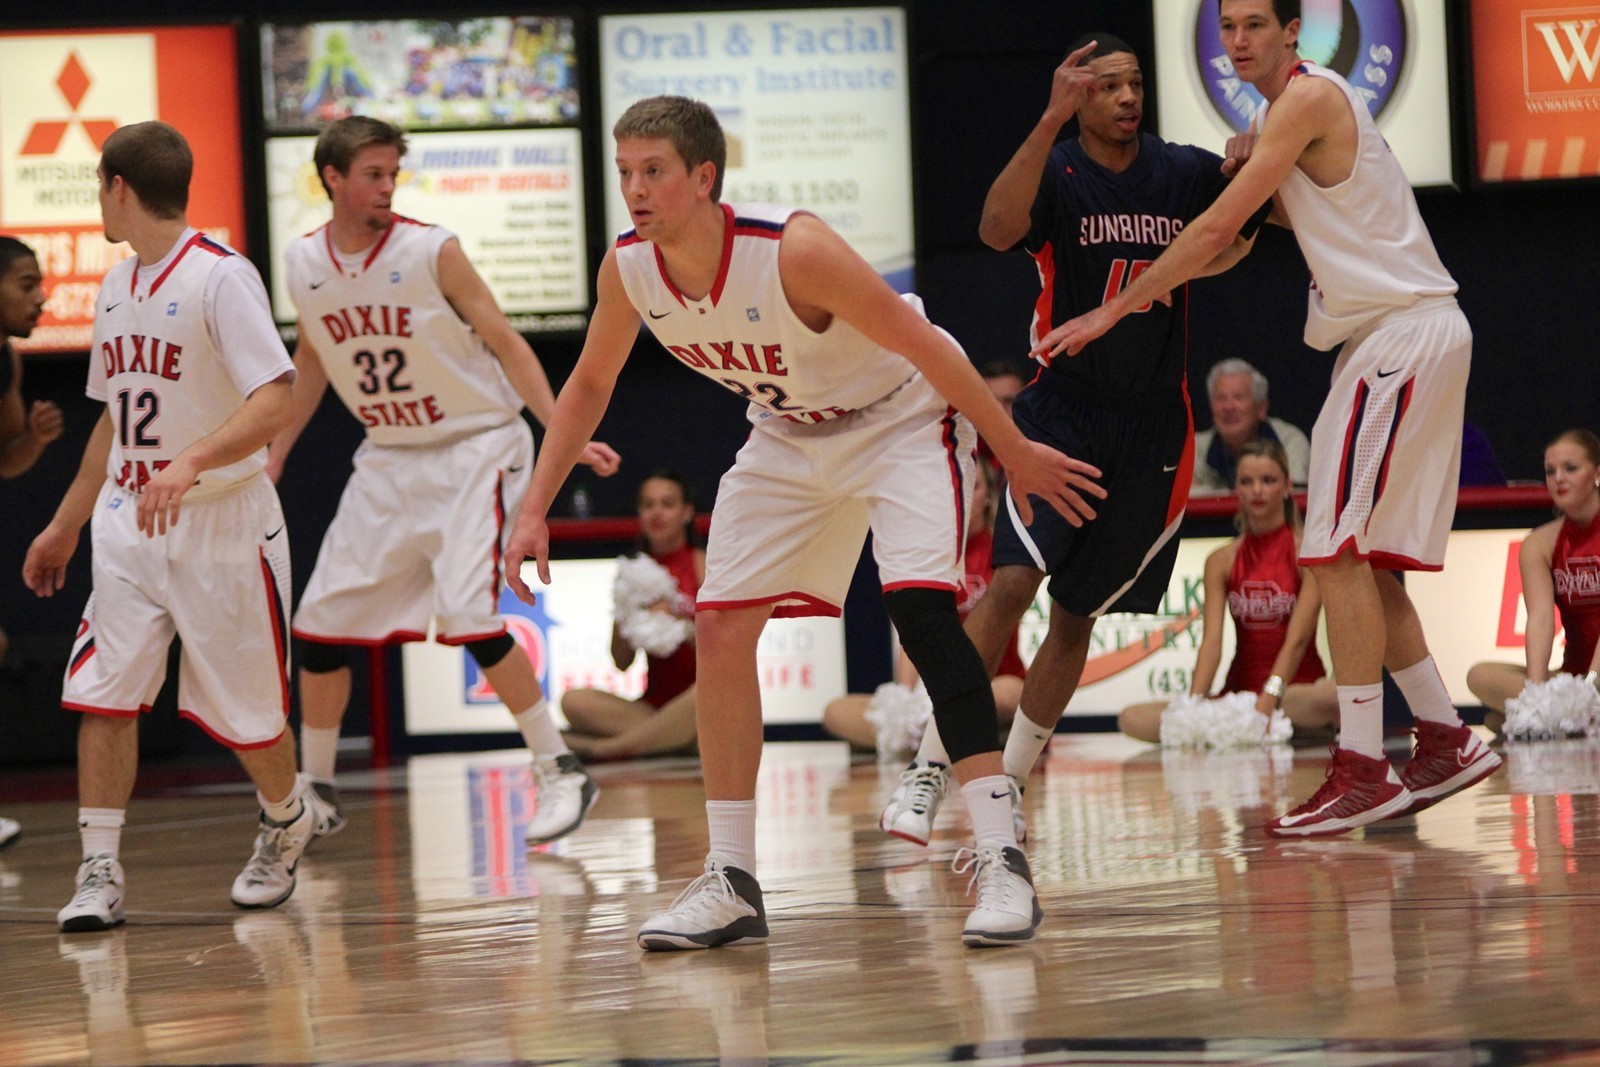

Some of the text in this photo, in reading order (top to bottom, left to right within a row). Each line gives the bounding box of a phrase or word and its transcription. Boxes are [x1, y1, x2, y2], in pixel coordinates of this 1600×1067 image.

[614, 15, 895, 60] Oral & Facial
[617, 65, 895, 98] Surgery Institute
[1079, 214, 1184, 246] SUNBIRDS
[321, 305, 414, 345] DIXIE
[102, 334, 183, 381] DIXIE
[353, 348, 413, 396] 32
[667, 341, 789, 377] DIXIE
[116, 388, 162, 449] 12
[357, 395, 446, 428] STATE
[1148, 666, 1196, 696] (43
